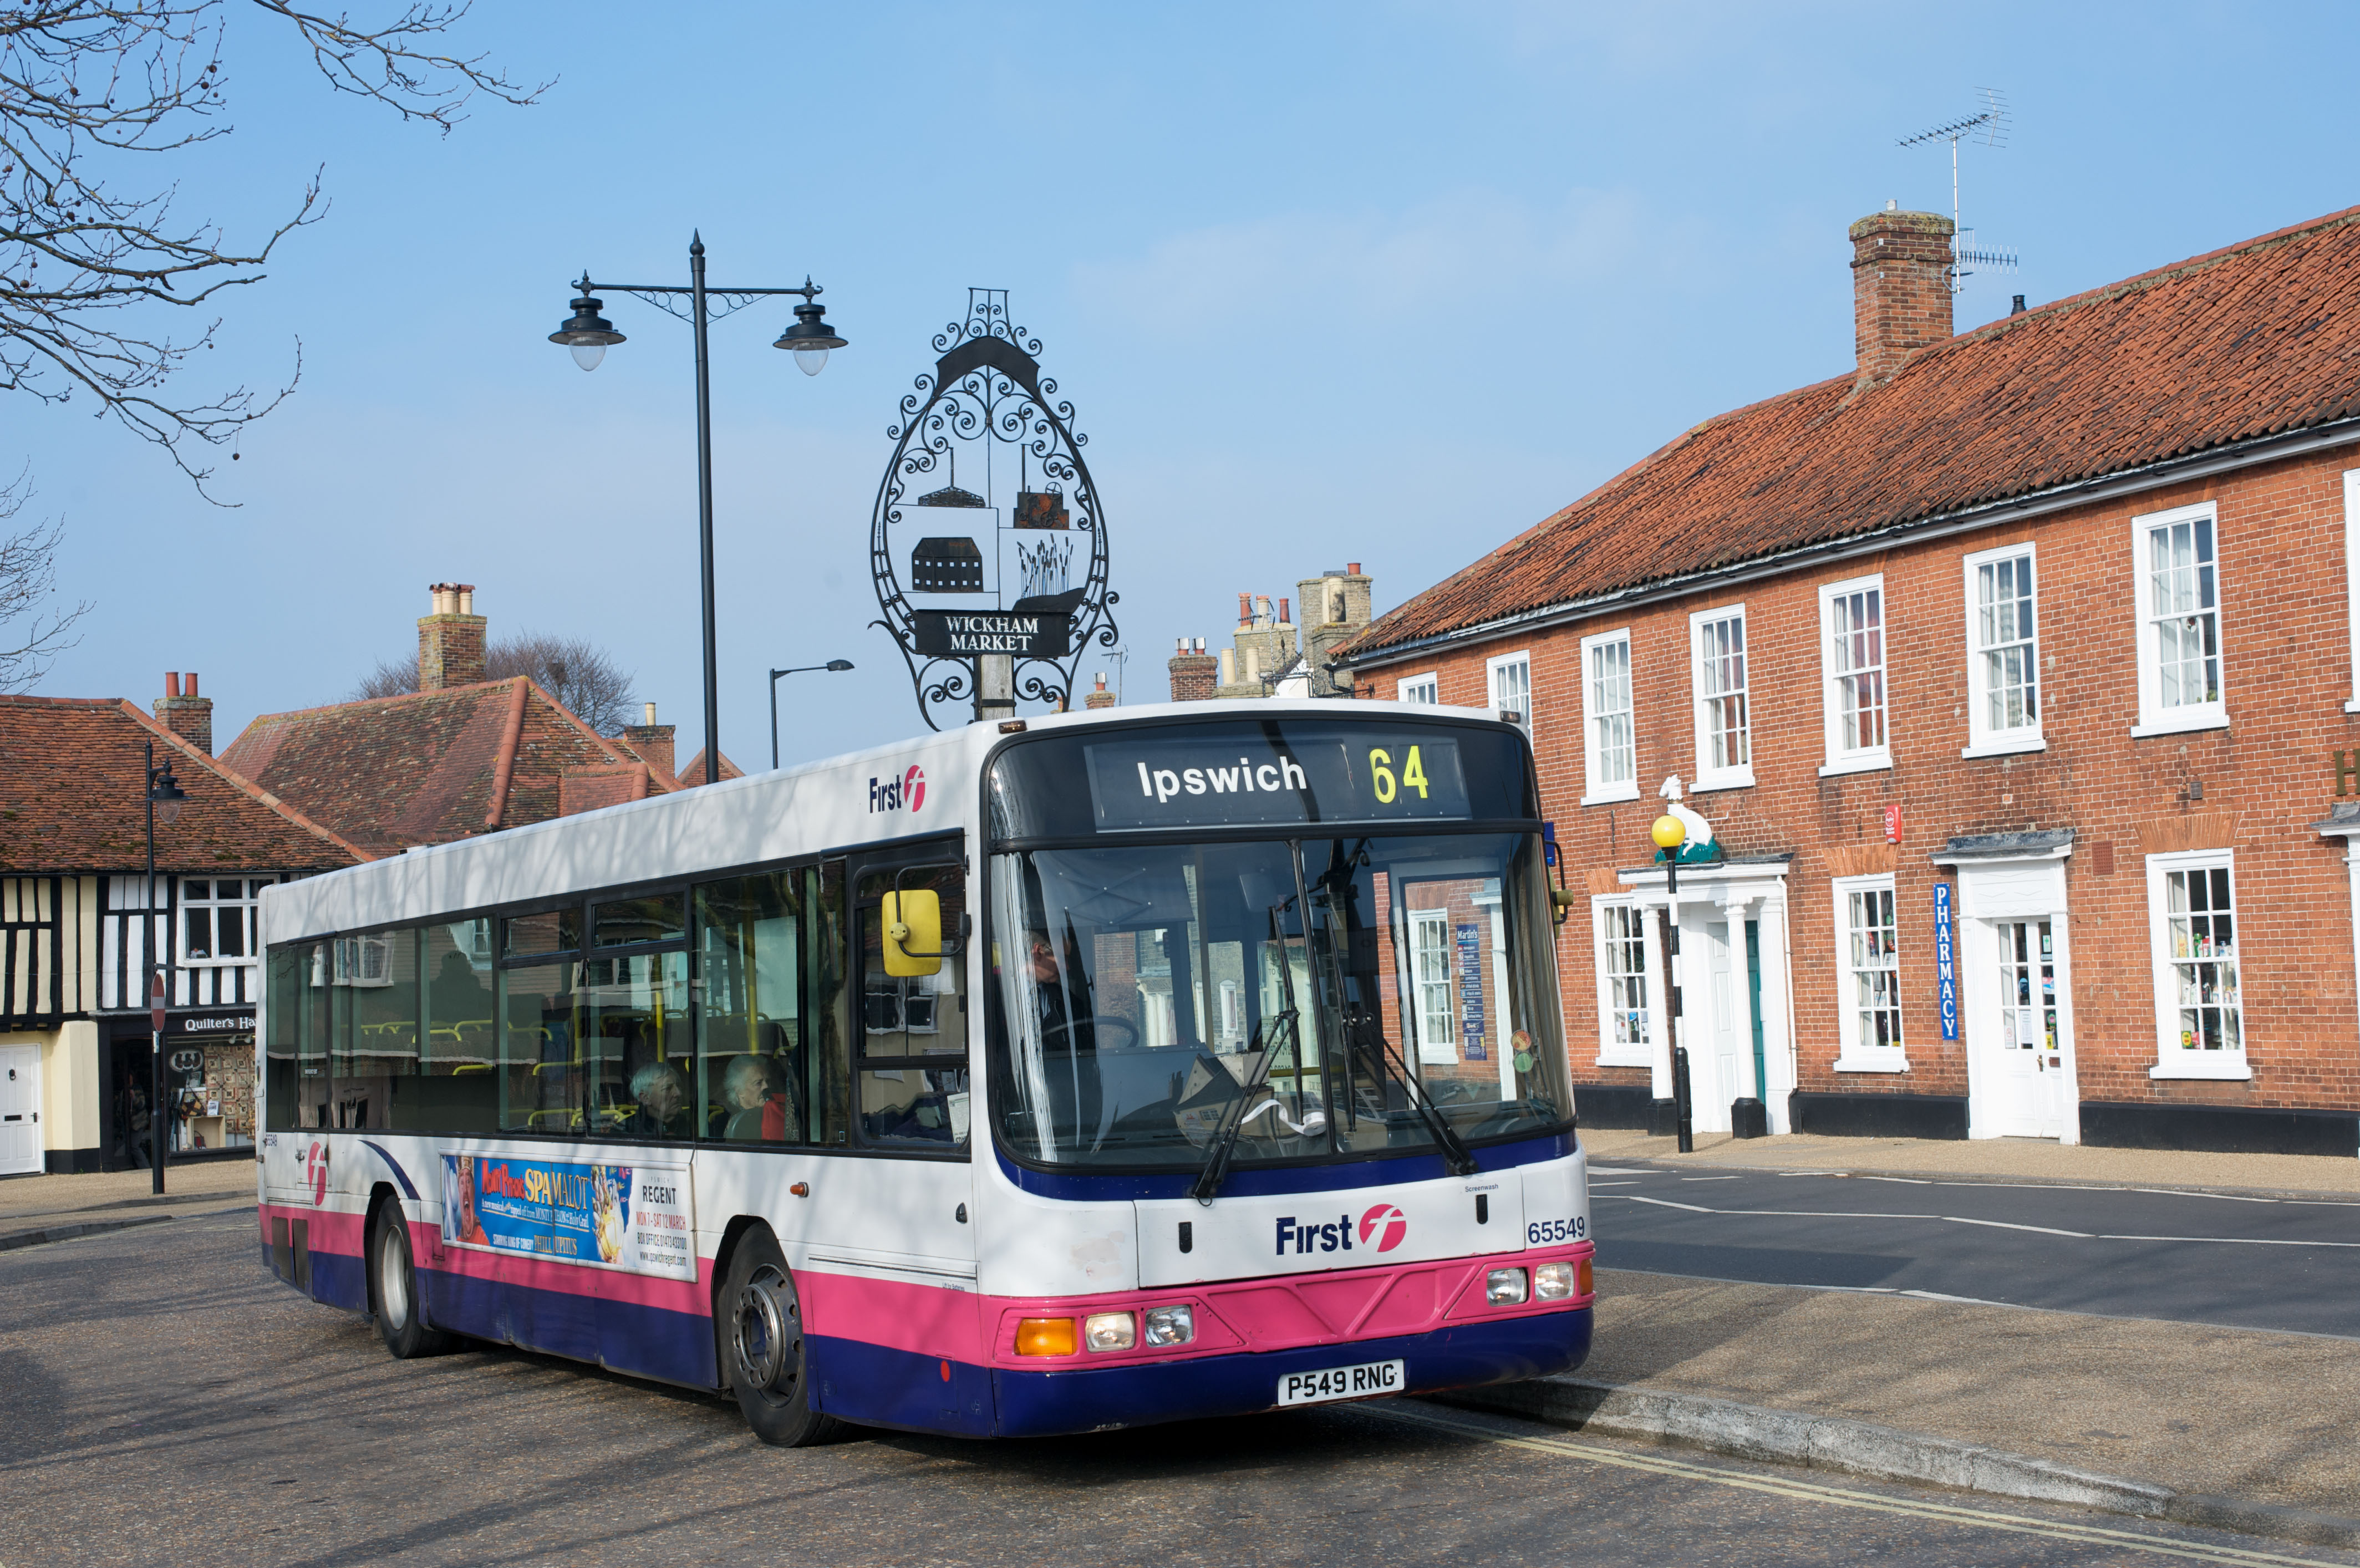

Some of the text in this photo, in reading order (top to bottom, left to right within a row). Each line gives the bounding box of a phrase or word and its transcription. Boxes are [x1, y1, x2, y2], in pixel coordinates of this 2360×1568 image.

[944, 616, 1039, 634] WICKHAM
[950, 634, 1033, 651] MARKET
[1137, 745, 1429, 803] Ipswich 64
[869, 775, 902, 814] First
[1457, 929, 1478, 940] Martin's
[1936, 887, 1955, 1036] PHARMACY
[185, 1017, 257, 1031] Quilter's Ha
[525, 1168, 589, 1210] SPAMALOT
[643, 1185, 676, 1205] REGENT
[1465, 1183, 1498, 1192] Screenwash
[636, 1211, 647, 1226] MON
[647, 1212, 650, 1226] 7
[653, 1213, 662, 1228] SAT
[663, 1214, 668, 1229] 12
[669, 1214, 686, 1230] MARCH
[1528, 1216, 1585, 1244] 65549
[534, 1234, 577, 1255] PHILL UPITUS
[637, 1232, 645, 1244] BOX
[646, 1233, 659, 1246] OFFICE
[1276, 1214, 1352, 1255] First
[639, 1249, 686, 1267] www.ipswichregent.com
[1288, 1363, 1395, 1399] P549 RNG
